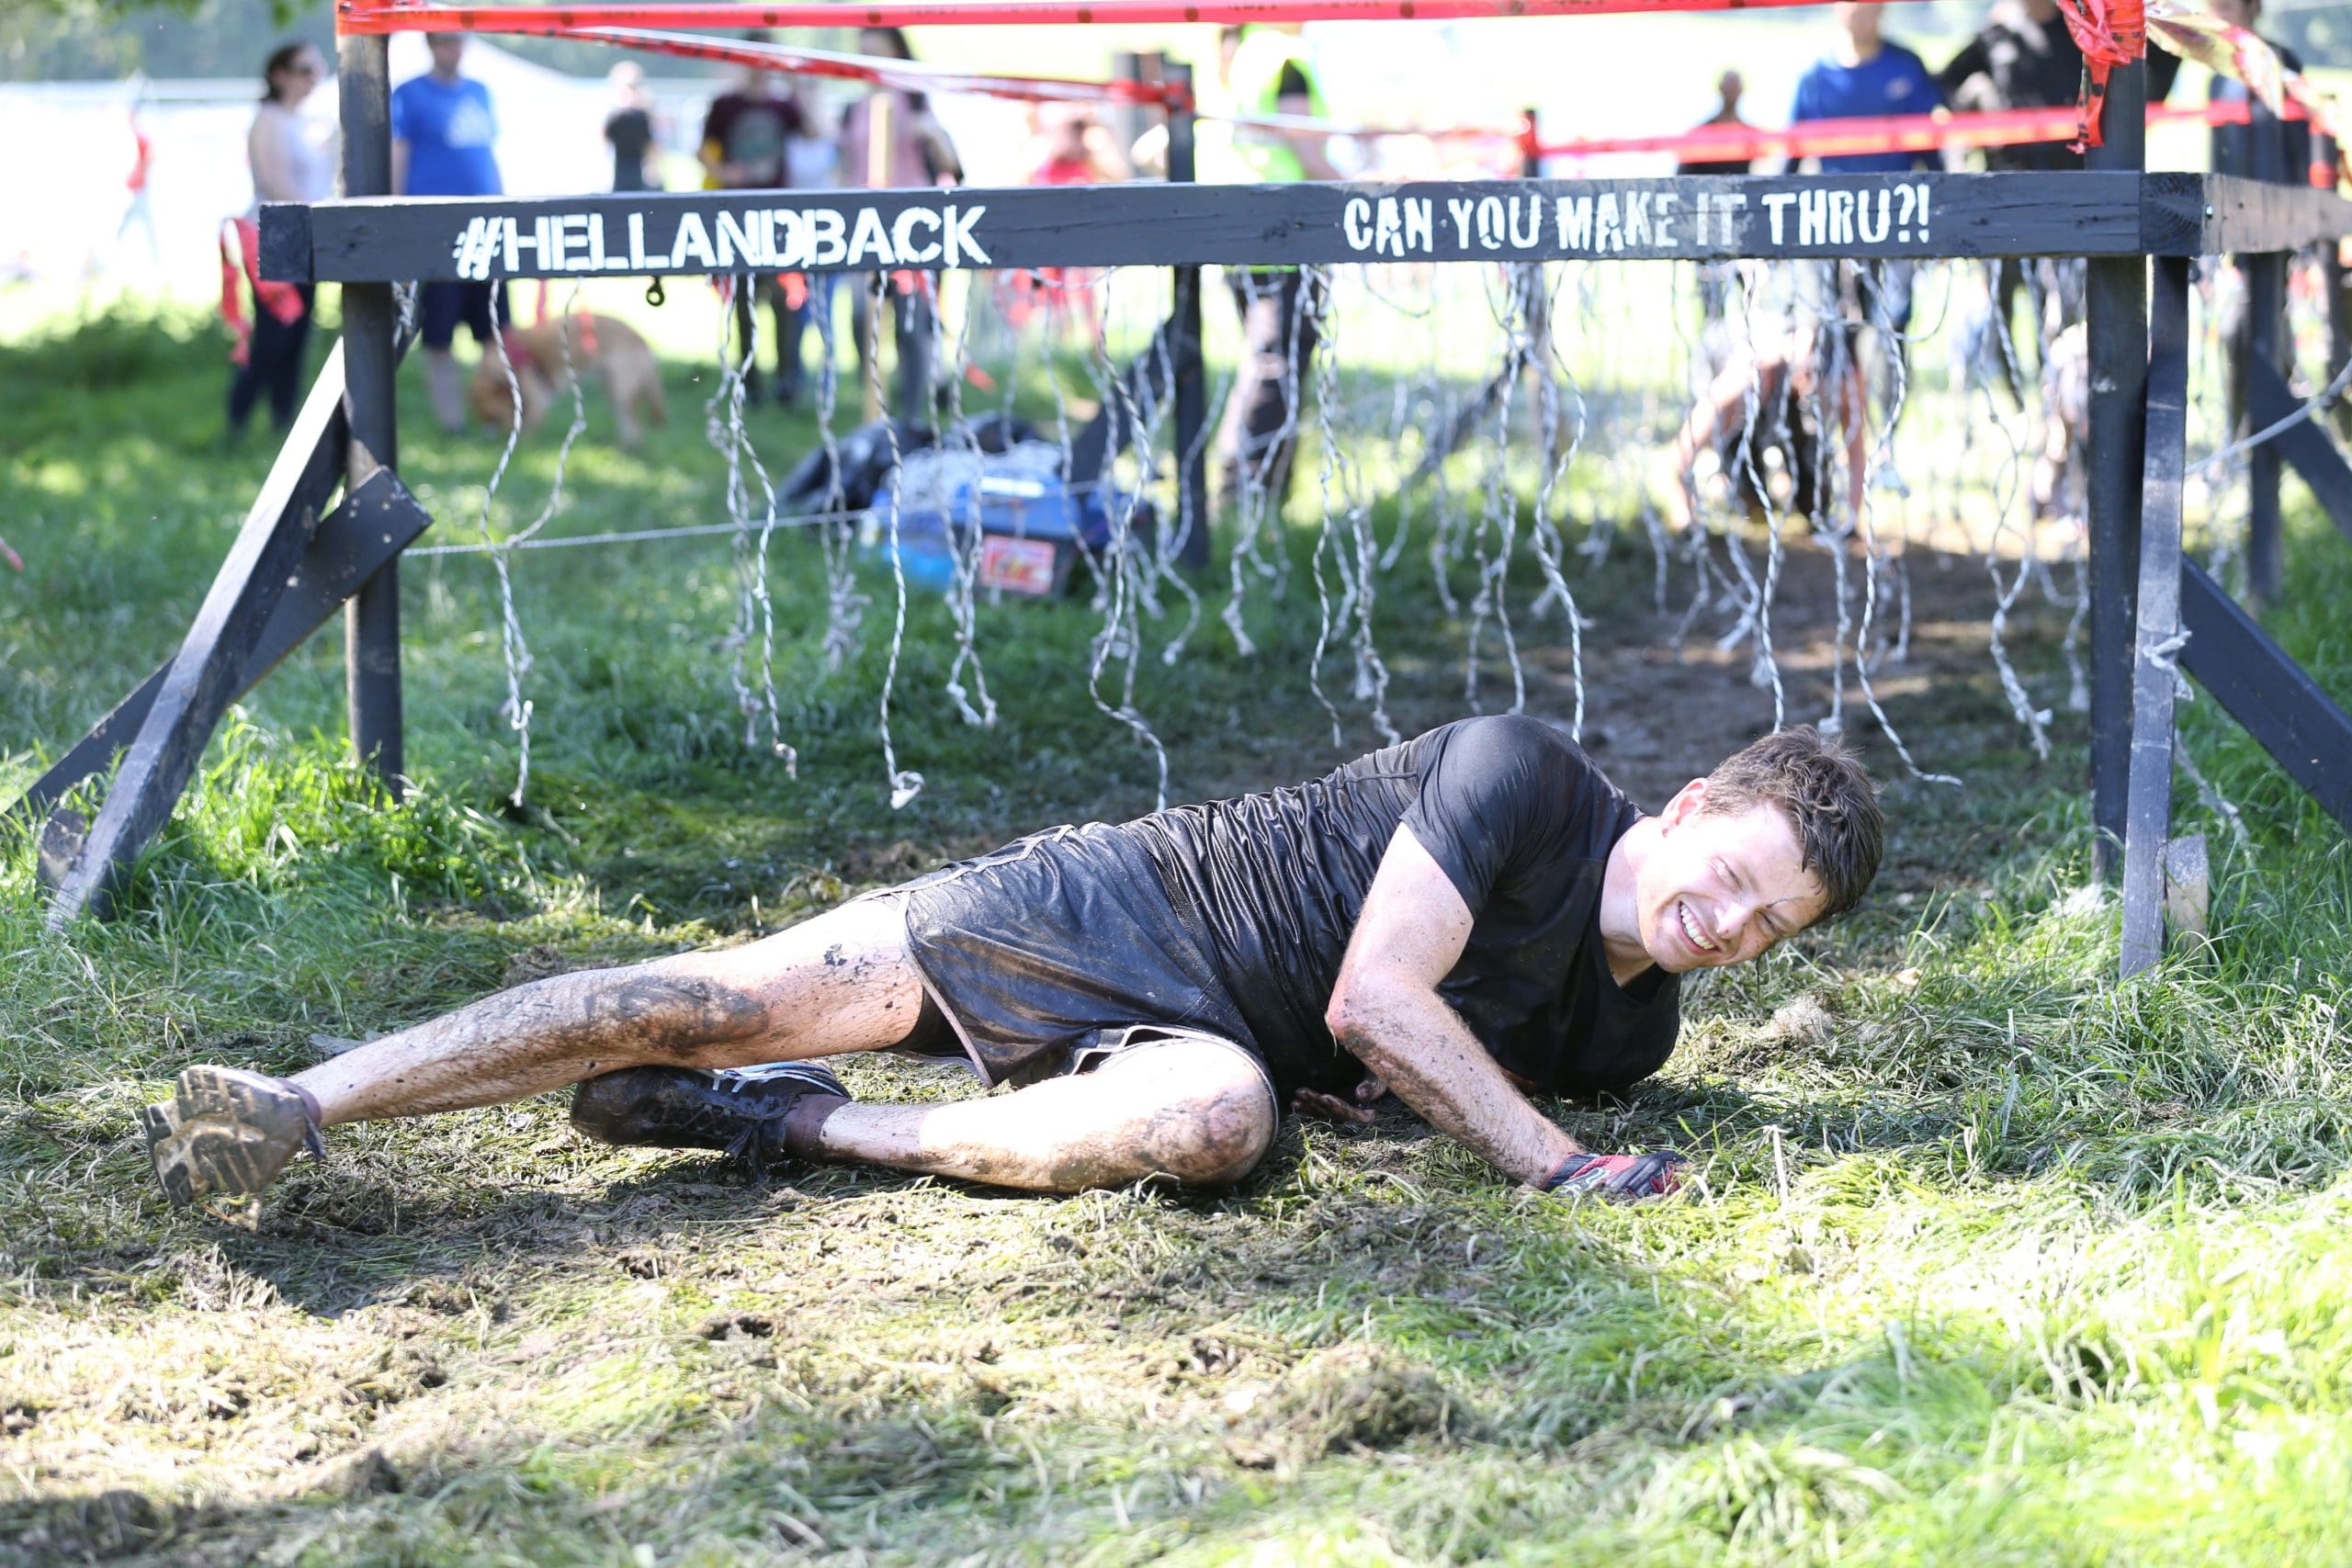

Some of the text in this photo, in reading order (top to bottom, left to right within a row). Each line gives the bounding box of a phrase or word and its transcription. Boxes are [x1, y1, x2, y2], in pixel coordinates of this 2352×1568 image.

[452, 205, 992, 280] #HELLANDBACK
[1343, 183, 1930, 257] CAN YOU MAKE IT THRU?!
